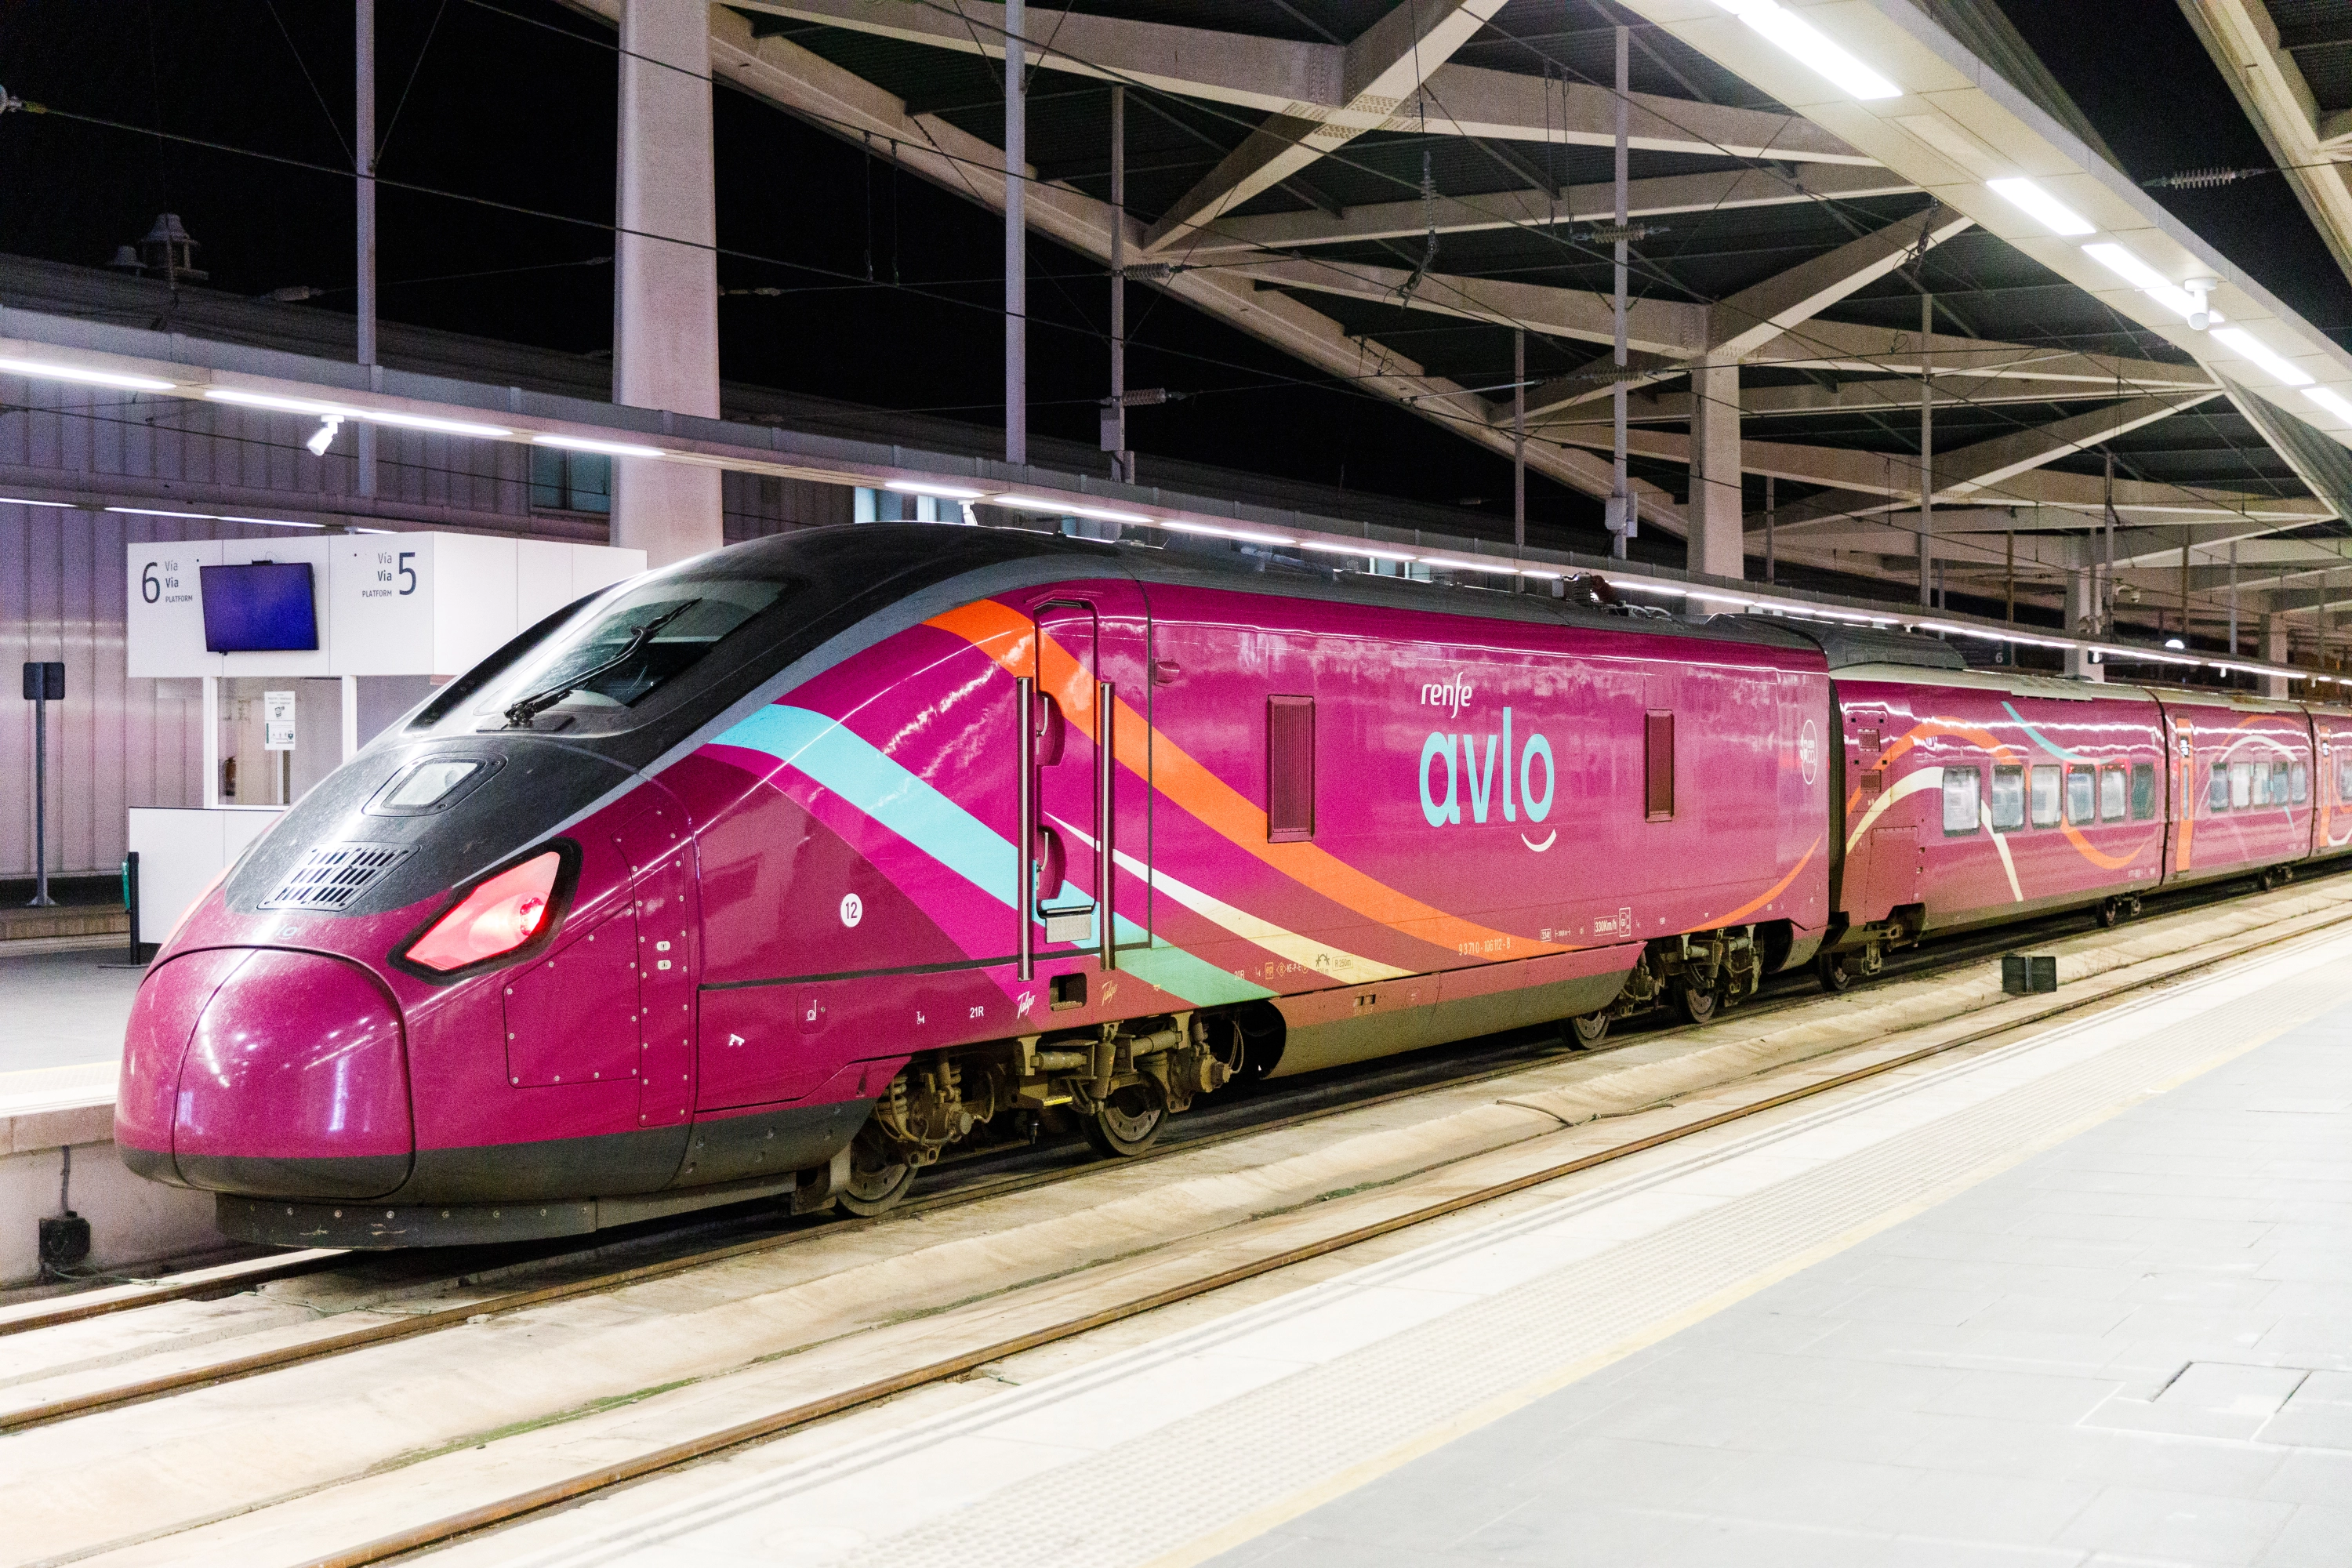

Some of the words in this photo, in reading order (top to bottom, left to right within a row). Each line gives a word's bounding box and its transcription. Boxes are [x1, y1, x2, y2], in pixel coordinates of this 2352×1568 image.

[165, 560, 178, 571] Vía
[378, 552, 392, 564] Vía
[142, 561, 160, 603] 6
[165, 577, 179, 588] Via
[377, 569, 392, 581] Via
[398, 552, 416, 595] 5
[1421, 672, 1472, 718] renfe
[1419, 706, 1555, 827] avlo
[845, 901, 858, 919] 12
[970, 1006, 984, 1018] 21R
[1017, 990, 1036, 1020] Talgo
